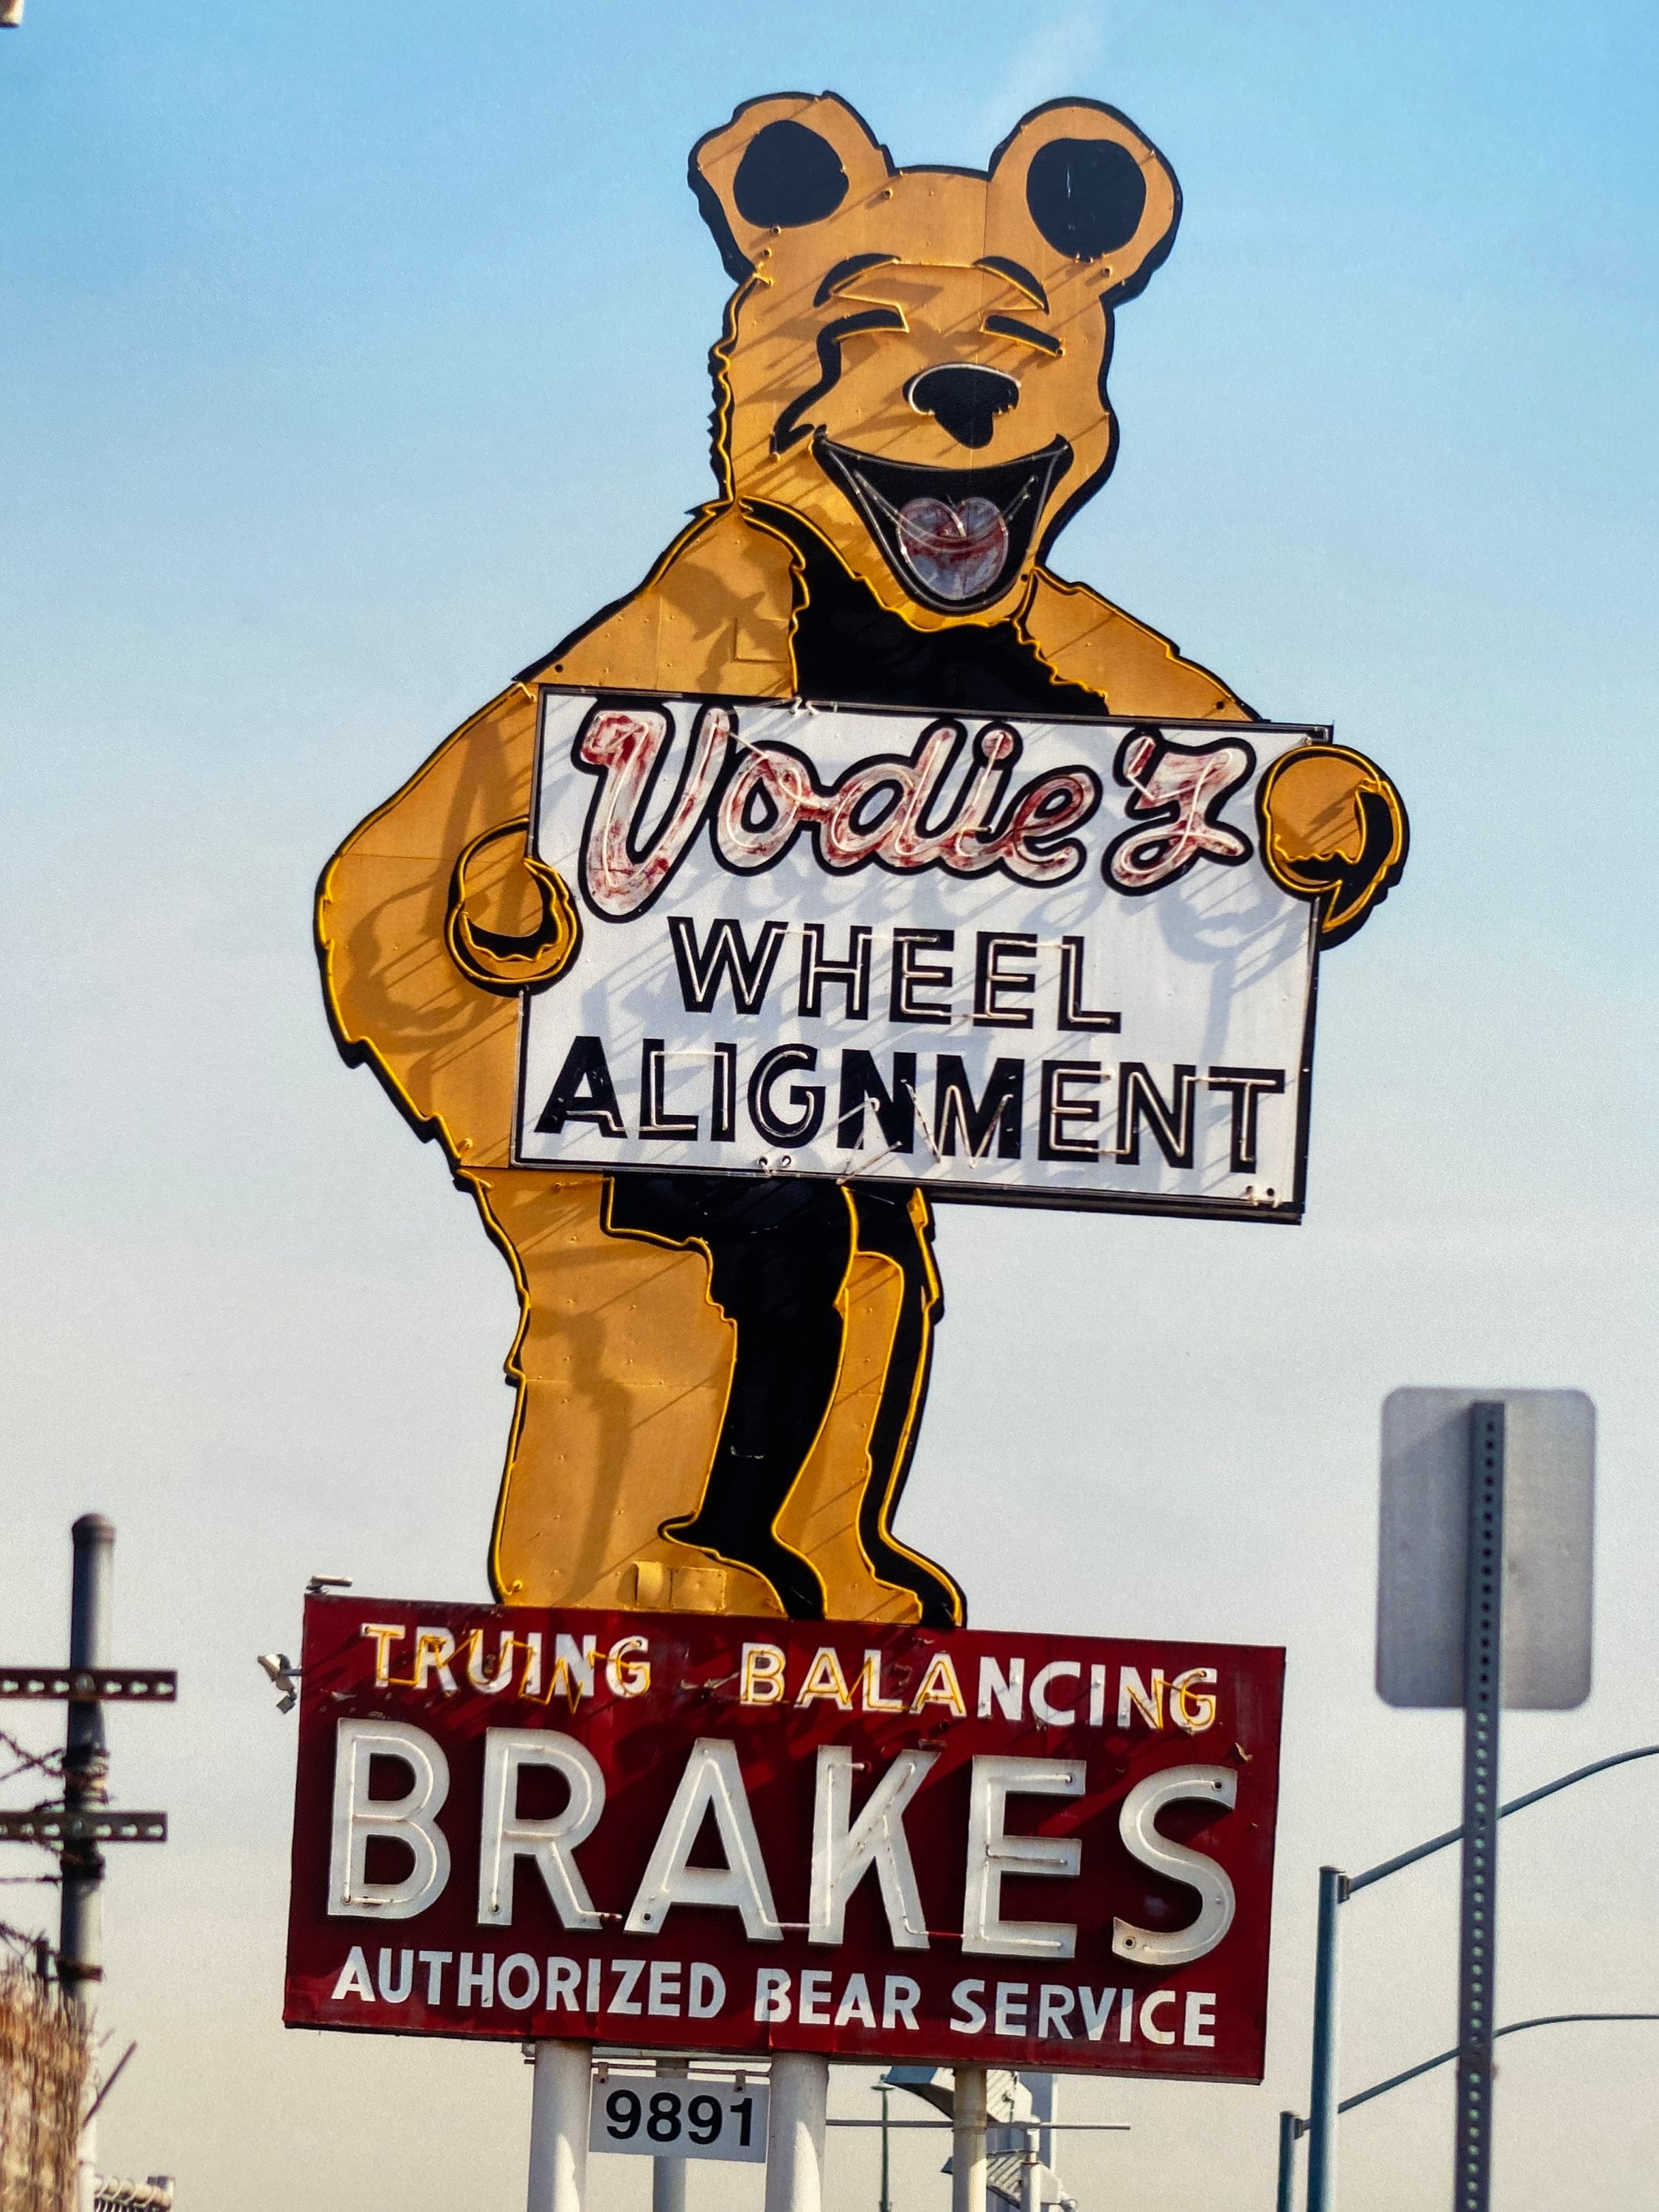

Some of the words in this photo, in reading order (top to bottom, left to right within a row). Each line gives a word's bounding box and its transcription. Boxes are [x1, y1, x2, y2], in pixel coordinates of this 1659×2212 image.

[668, 916, 1122, 1034] WHEEL
[535, 1036, 1285, 1174] ALIGNMENT
[361, 1623, 650, 1700] TRUING
[739, 1641, 1217, 1733] BALANCING
[327, 1717, 1238, 1967] BRAKES
[331, 1947, 726, 2020] AUTHORIZED
[754, 1967, 920, 2031] BEAR
[950, 1978, 1217, 2049] SERVICE
[605, 2089, 755, 2149] 9891
